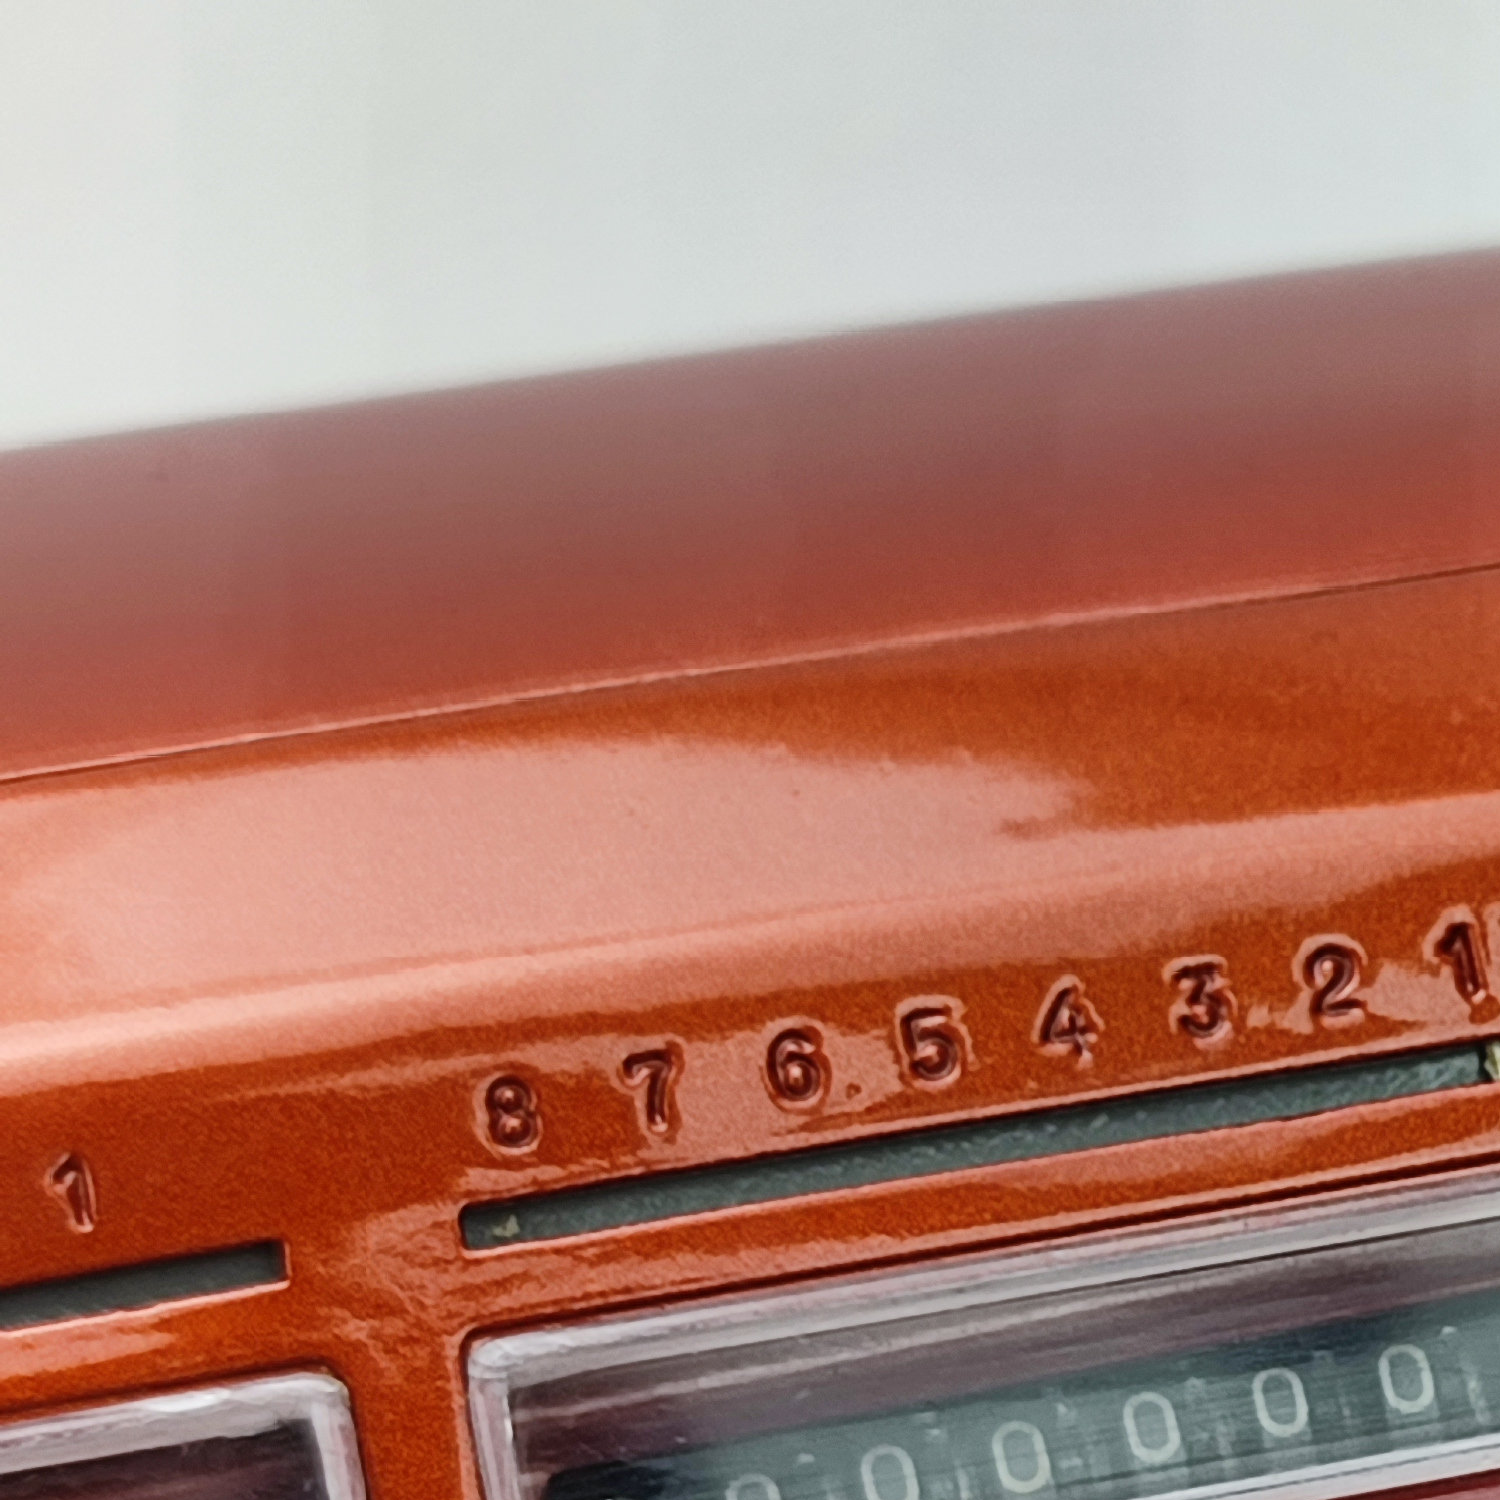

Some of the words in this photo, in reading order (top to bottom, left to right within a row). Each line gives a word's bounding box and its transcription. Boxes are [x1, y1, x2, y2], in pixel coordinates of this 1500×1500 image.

[483, 1075, 541, 1151] 8
[622, 1043, 684, 1132] 7
[766, 1025, 826, 1102] 6
[901, 1003, 960, 1082] 5
[1040, 983, 1097, 1064] 4
[1171, 961, 1232, 1043] 3
[1307, 942, 1366, 1022] 2
[1430, 915, 1490, 1003] 1
[47, 1152, 97, 1233] 1
[992, 1421, 1051, 1493] 0
[1123, 1392, 1181, 1463] 0
[1252, 1368, 1310, 1437] 0
[1378, 1344, 1435, 1413] 0
